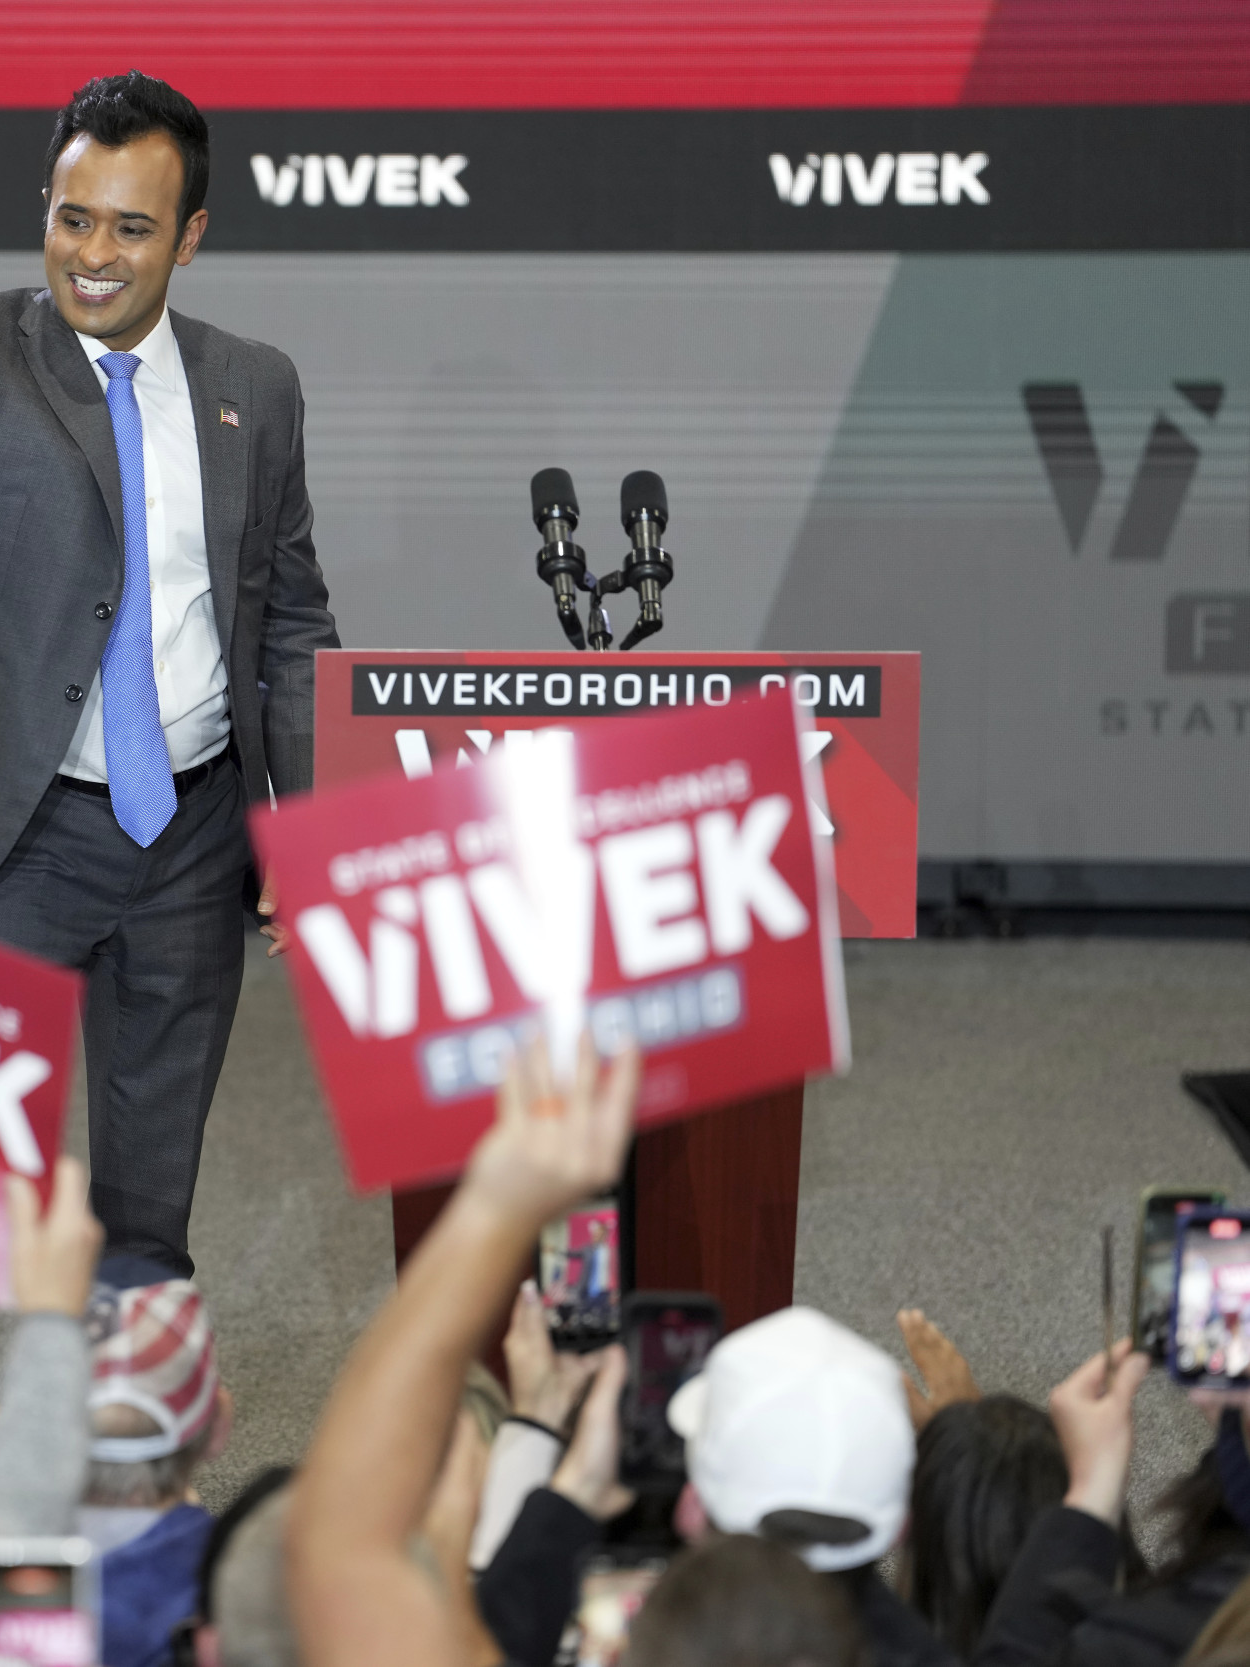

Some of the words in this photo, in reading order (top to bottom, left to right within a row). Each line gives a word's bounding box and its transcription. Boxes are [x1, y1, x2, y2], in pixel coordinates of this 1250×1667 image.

[250, 153, 470, 207] VIVEK
[768, 151, 991, 206] VIVEK
[296, 793, 810, 1040] VIVEK
